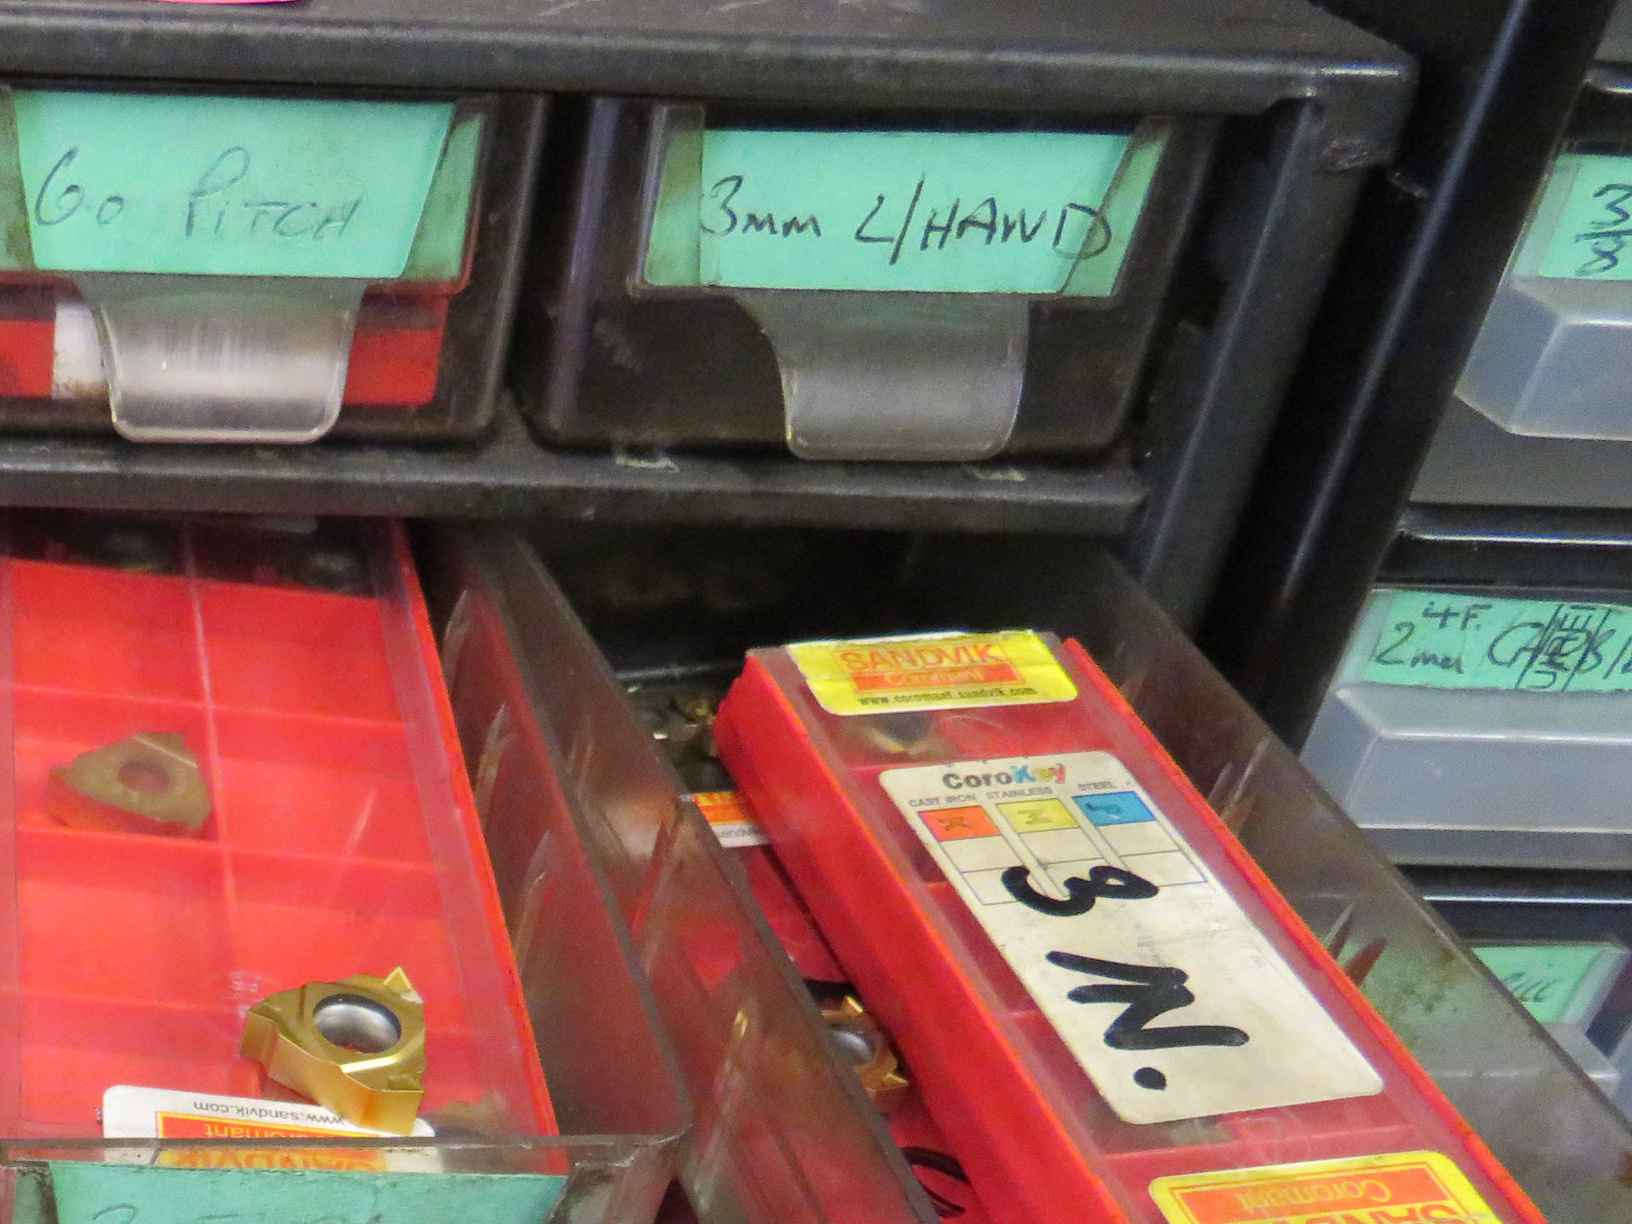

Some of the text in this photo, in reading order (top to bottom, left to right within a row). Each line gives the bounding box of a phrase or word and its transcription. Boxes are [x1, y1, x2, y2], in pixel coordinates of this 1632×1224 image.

[839, 643, 1005, 671] SANDVIK
[942, 763, 1067, 790] CoroKey
[1077, 779, 1118, 792] STEEL
[908, 795, 941, 808] CAST
[1001, 865, 1160, 917] 3
[1236, 1177, 1393, 1214] Coromant
